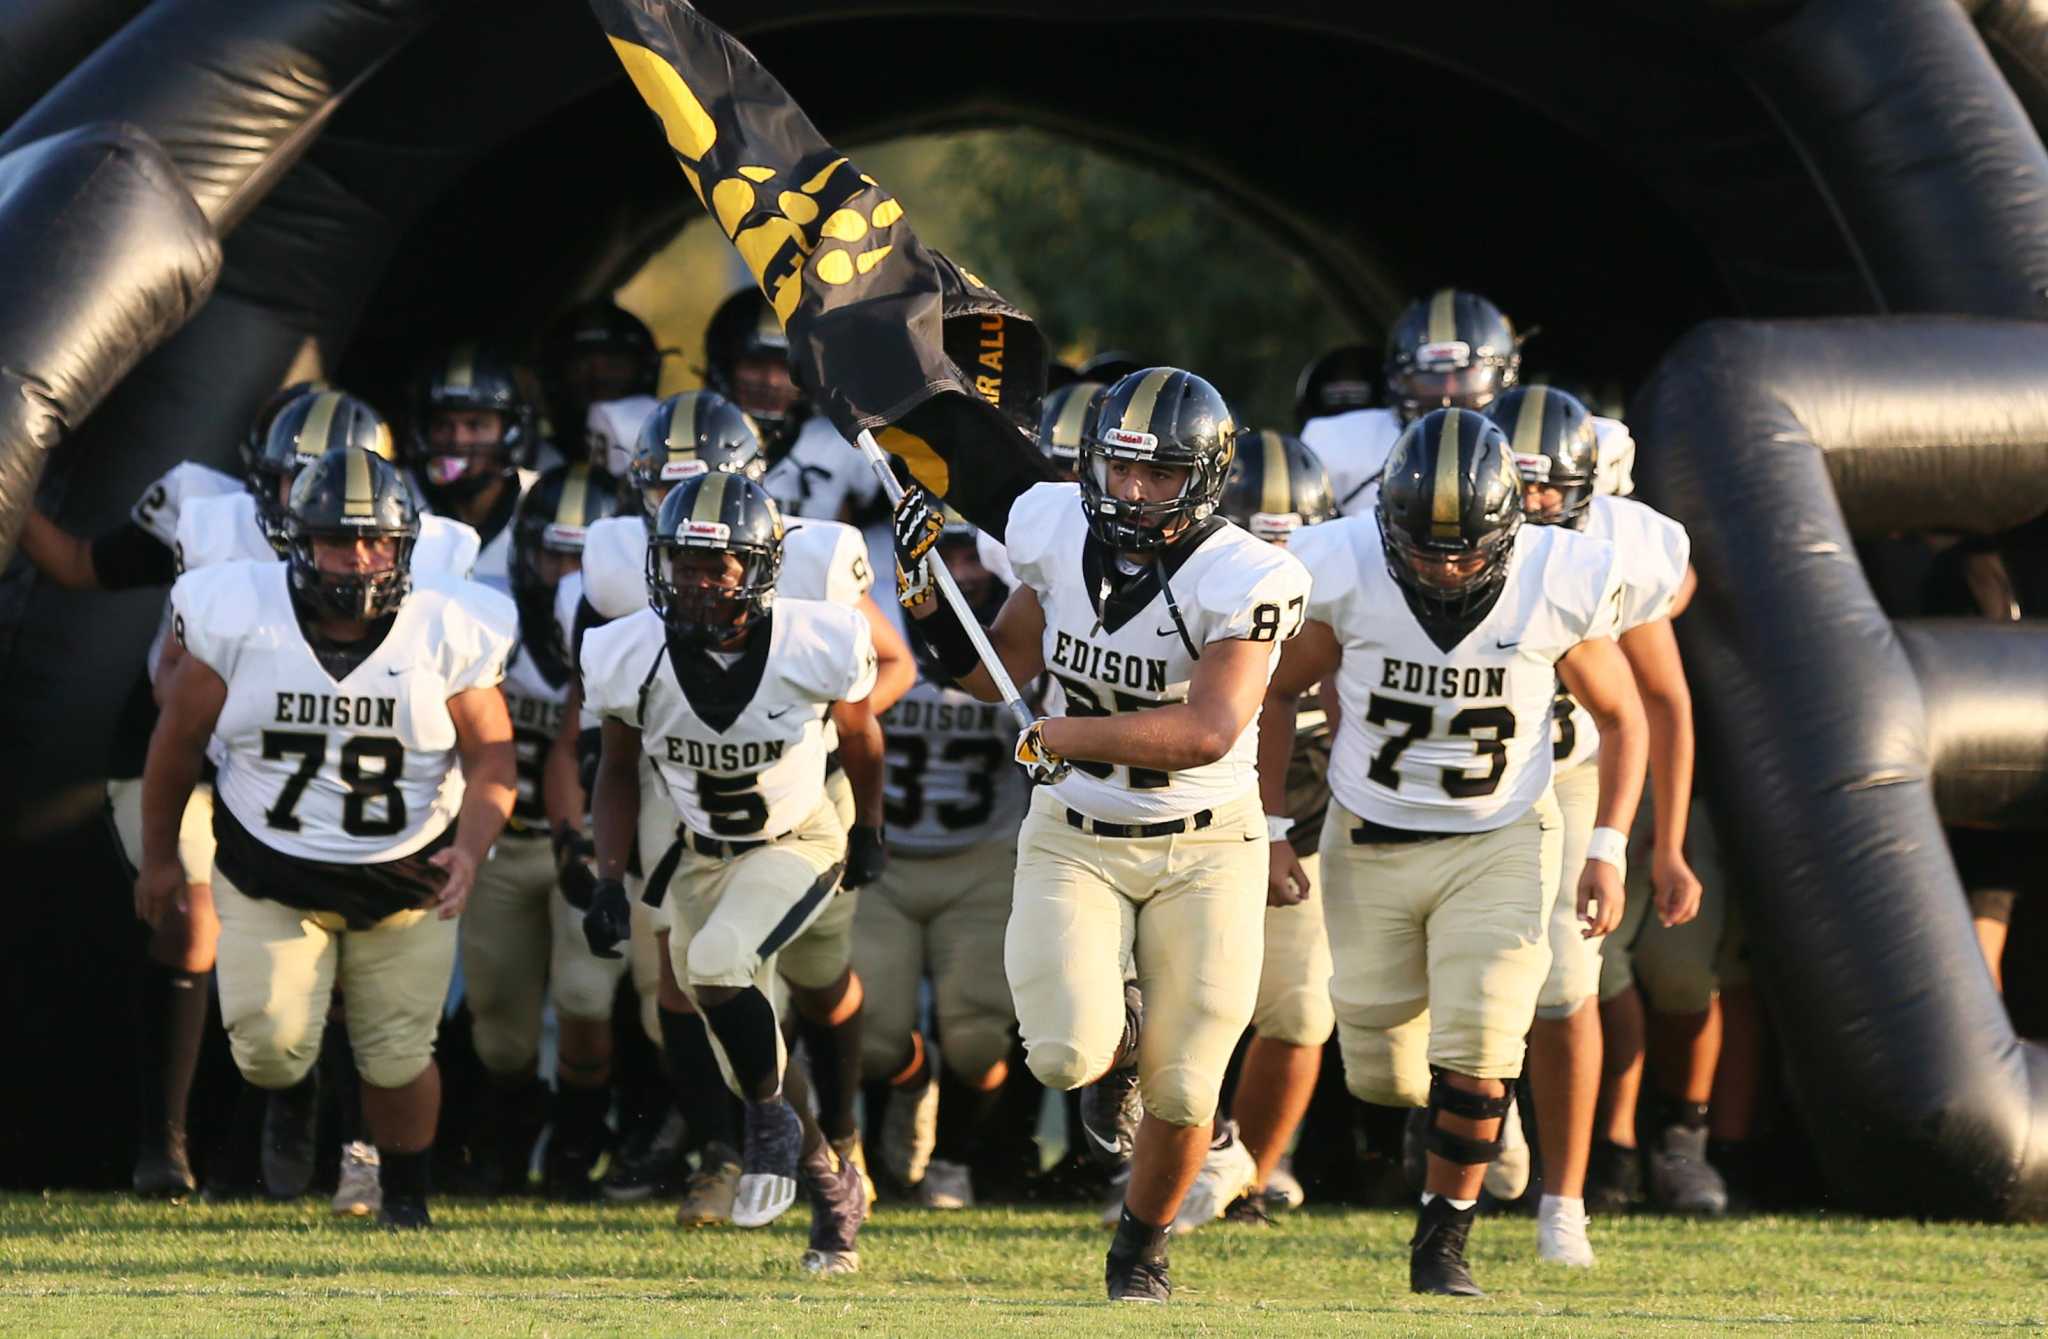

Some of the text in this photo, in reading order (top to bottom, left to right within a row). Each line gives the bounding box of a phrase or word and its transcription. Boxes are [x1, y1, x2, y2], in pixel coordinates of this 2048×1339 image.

[1250, 595, 1304, 642] 87
[1052, 630, 1167, 692] EDISON
[1381, 657, 1506, 698] EDISON
[276, 692, 395, 727] EDISON
[664, 735, 784, 771] EDISON
[1366, 692, 1516, 799] 73
[262, 731, 406, 836] 78
[696, 772, 769, 836] 5
